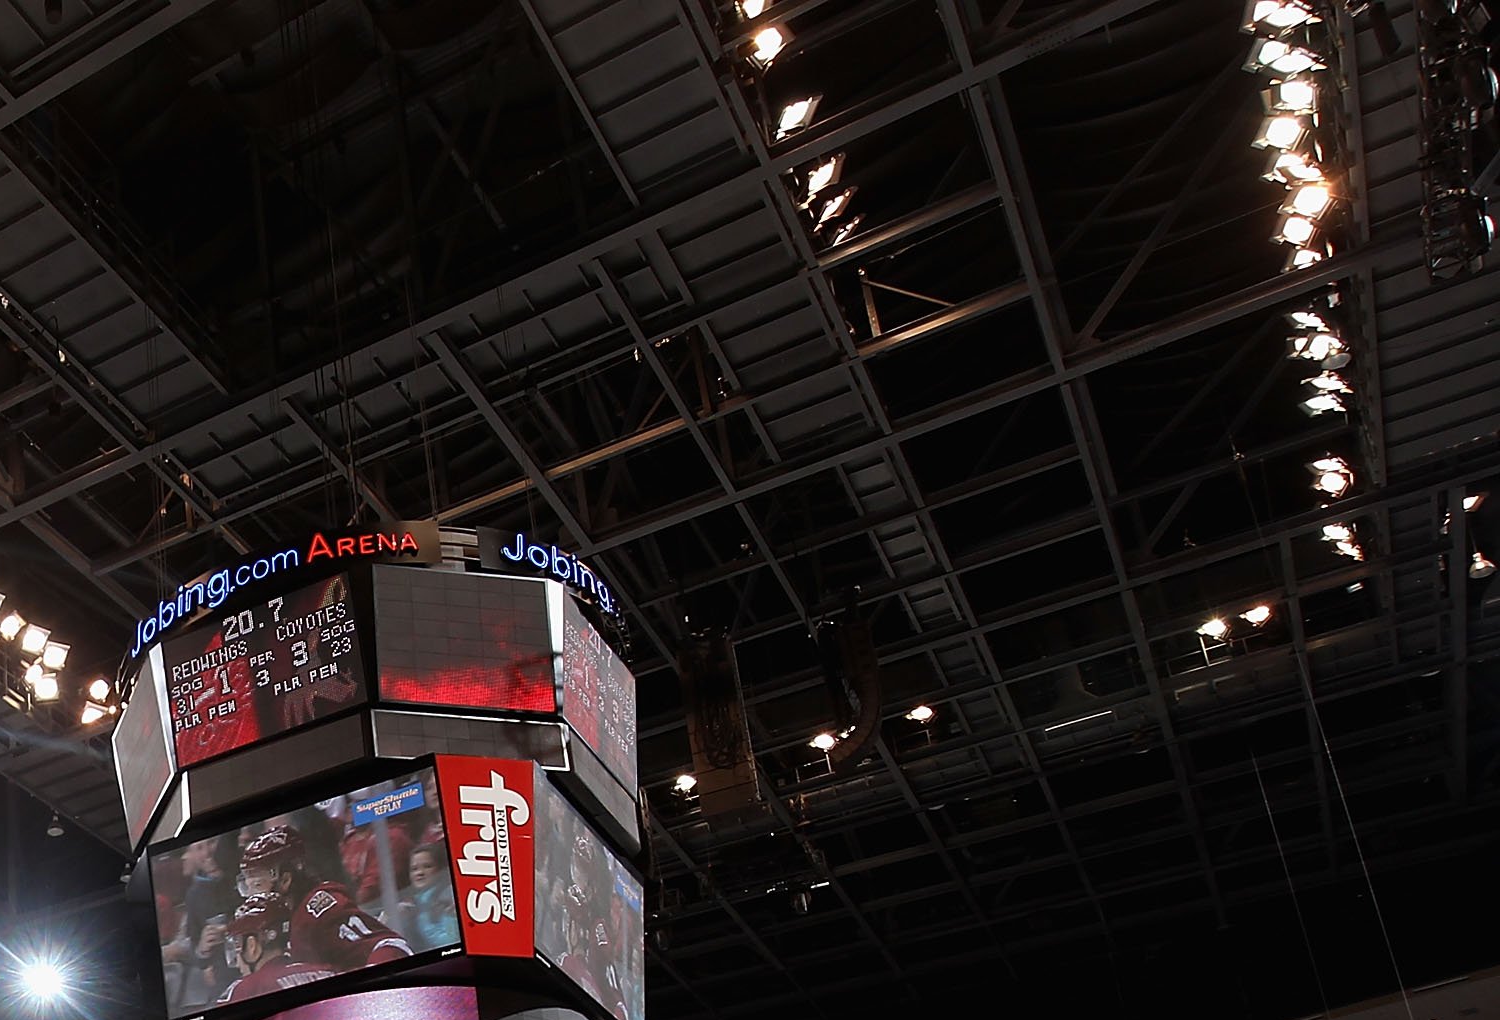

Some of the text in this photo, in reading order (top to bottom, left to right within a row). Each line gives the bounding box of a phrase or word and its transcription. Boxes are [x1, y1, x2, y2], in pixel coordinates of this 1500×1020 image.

[131, 532, 420, 658] Jobing.com ARENA
[276, 602, 346, 642] COYOTES
[320, 619, 355, 642] SOG
[172, 640, 248, 682] REDWINGS
[250, 650, 276, 667] PER
[291, 640, 309, 667] 3
[330, 637, 352, 658] 23
[171, 677, 204, 698] SOG
[256, 670, 271, 687] 3
[273, 662, 339, 696] PLR PEN
[175, 700, 237, 732] PLR PEN
[356, 786, 419, 813] SuperShuttle
[374, 800, 403, 816] REPLAY
[458, 770, 530, 924] fry's
[495, 809, 514, 913] FOOD STORES
